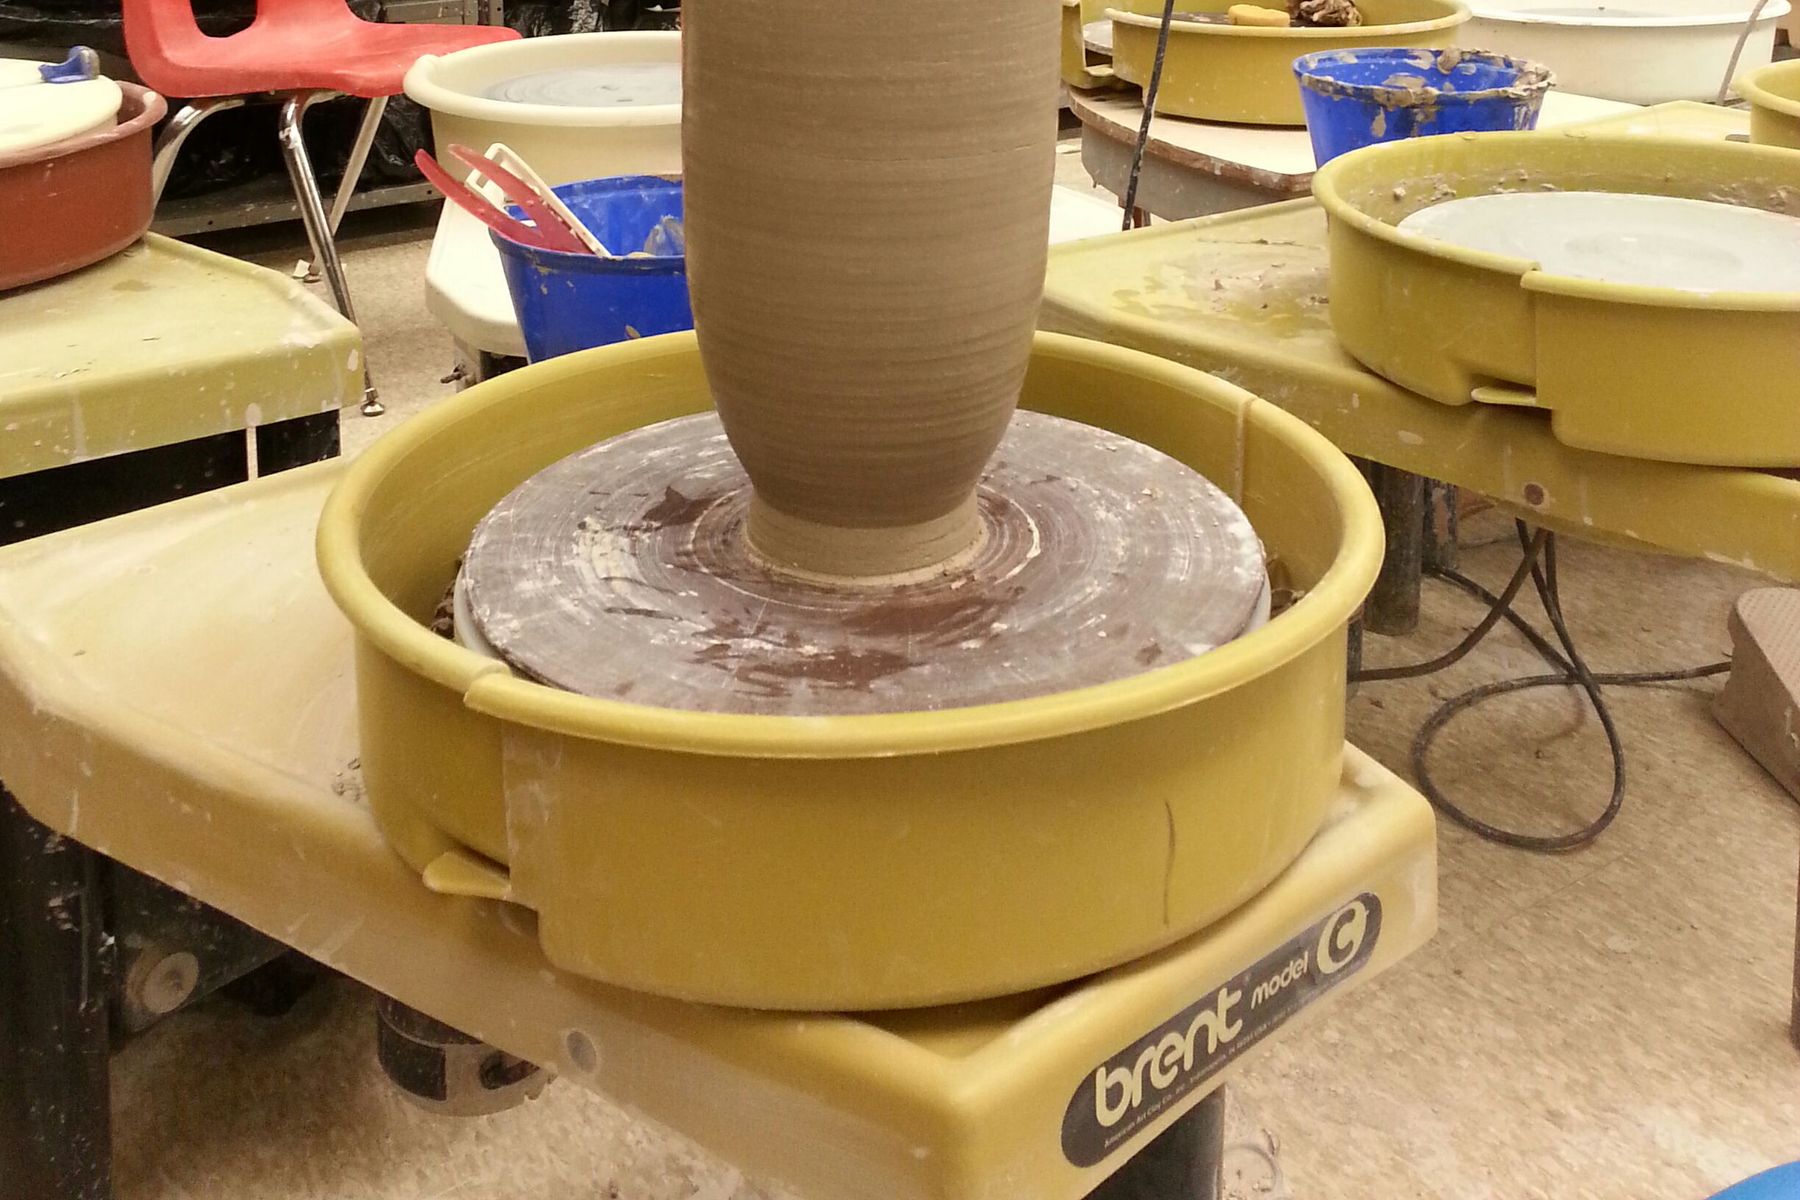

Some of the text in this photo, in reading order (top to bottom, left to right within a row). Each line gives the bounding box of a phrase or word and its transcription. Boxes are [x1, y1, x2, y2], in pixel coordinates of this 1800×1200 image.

[1095, 987, 1243, 1127] brent
[1251, 950, 1309, 1010] model
[1326, 905, 1358, 966] C
